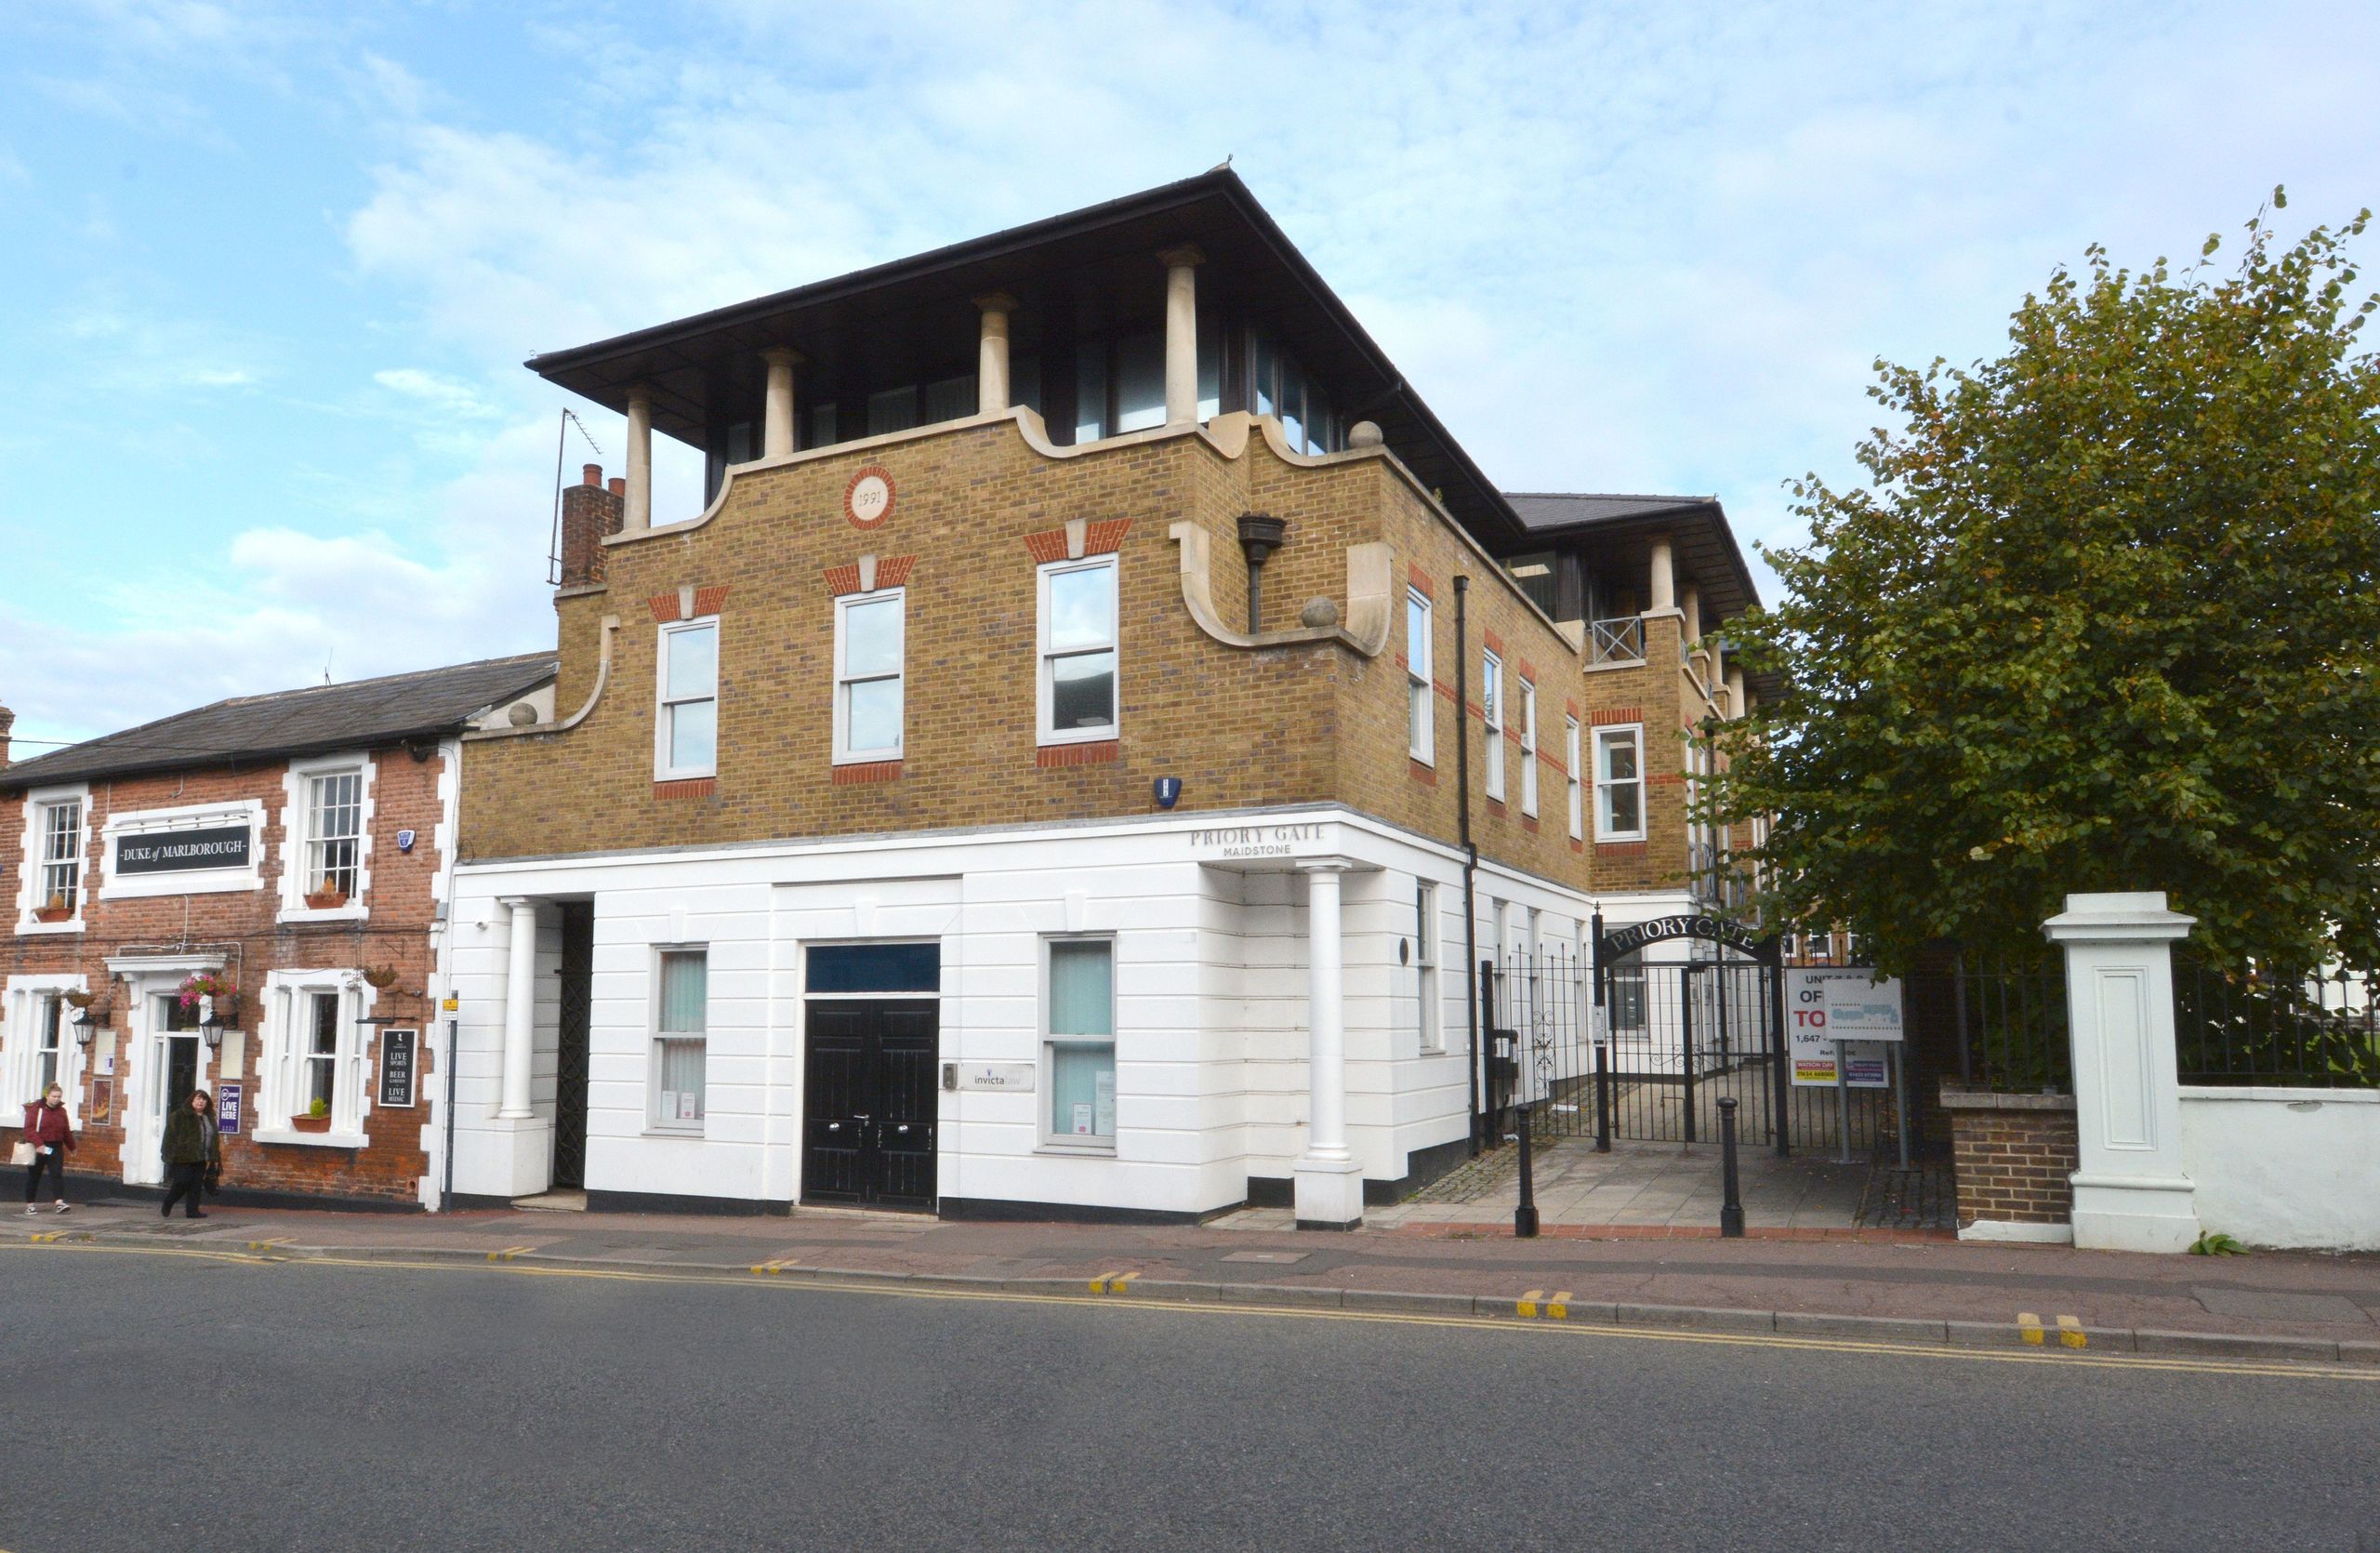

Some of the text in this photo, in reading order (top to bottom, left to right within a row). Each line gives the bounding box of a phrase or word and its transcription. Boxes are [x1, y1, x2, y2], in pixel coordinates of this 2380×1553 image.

[858, 491, 881, 507] 1991
[1190, 822, 1325, 846] PRIORY GATE
[152, 846, 162, 862] of
[1223, 844, 1291, 856] MAIDSTONE
[1611, 916, 1691, 952] PRIORY
[1793, 1010, 1826, 1028] TO
[1795, 1035, 1820, 1043] 1,647
[390, 1052, 408, 1060] LIVE
[388, 1087, 405, 1096] LIVE
[221, 1101, 238, 1111] LIVE
[220, 1110, 237, 1120] HERE
